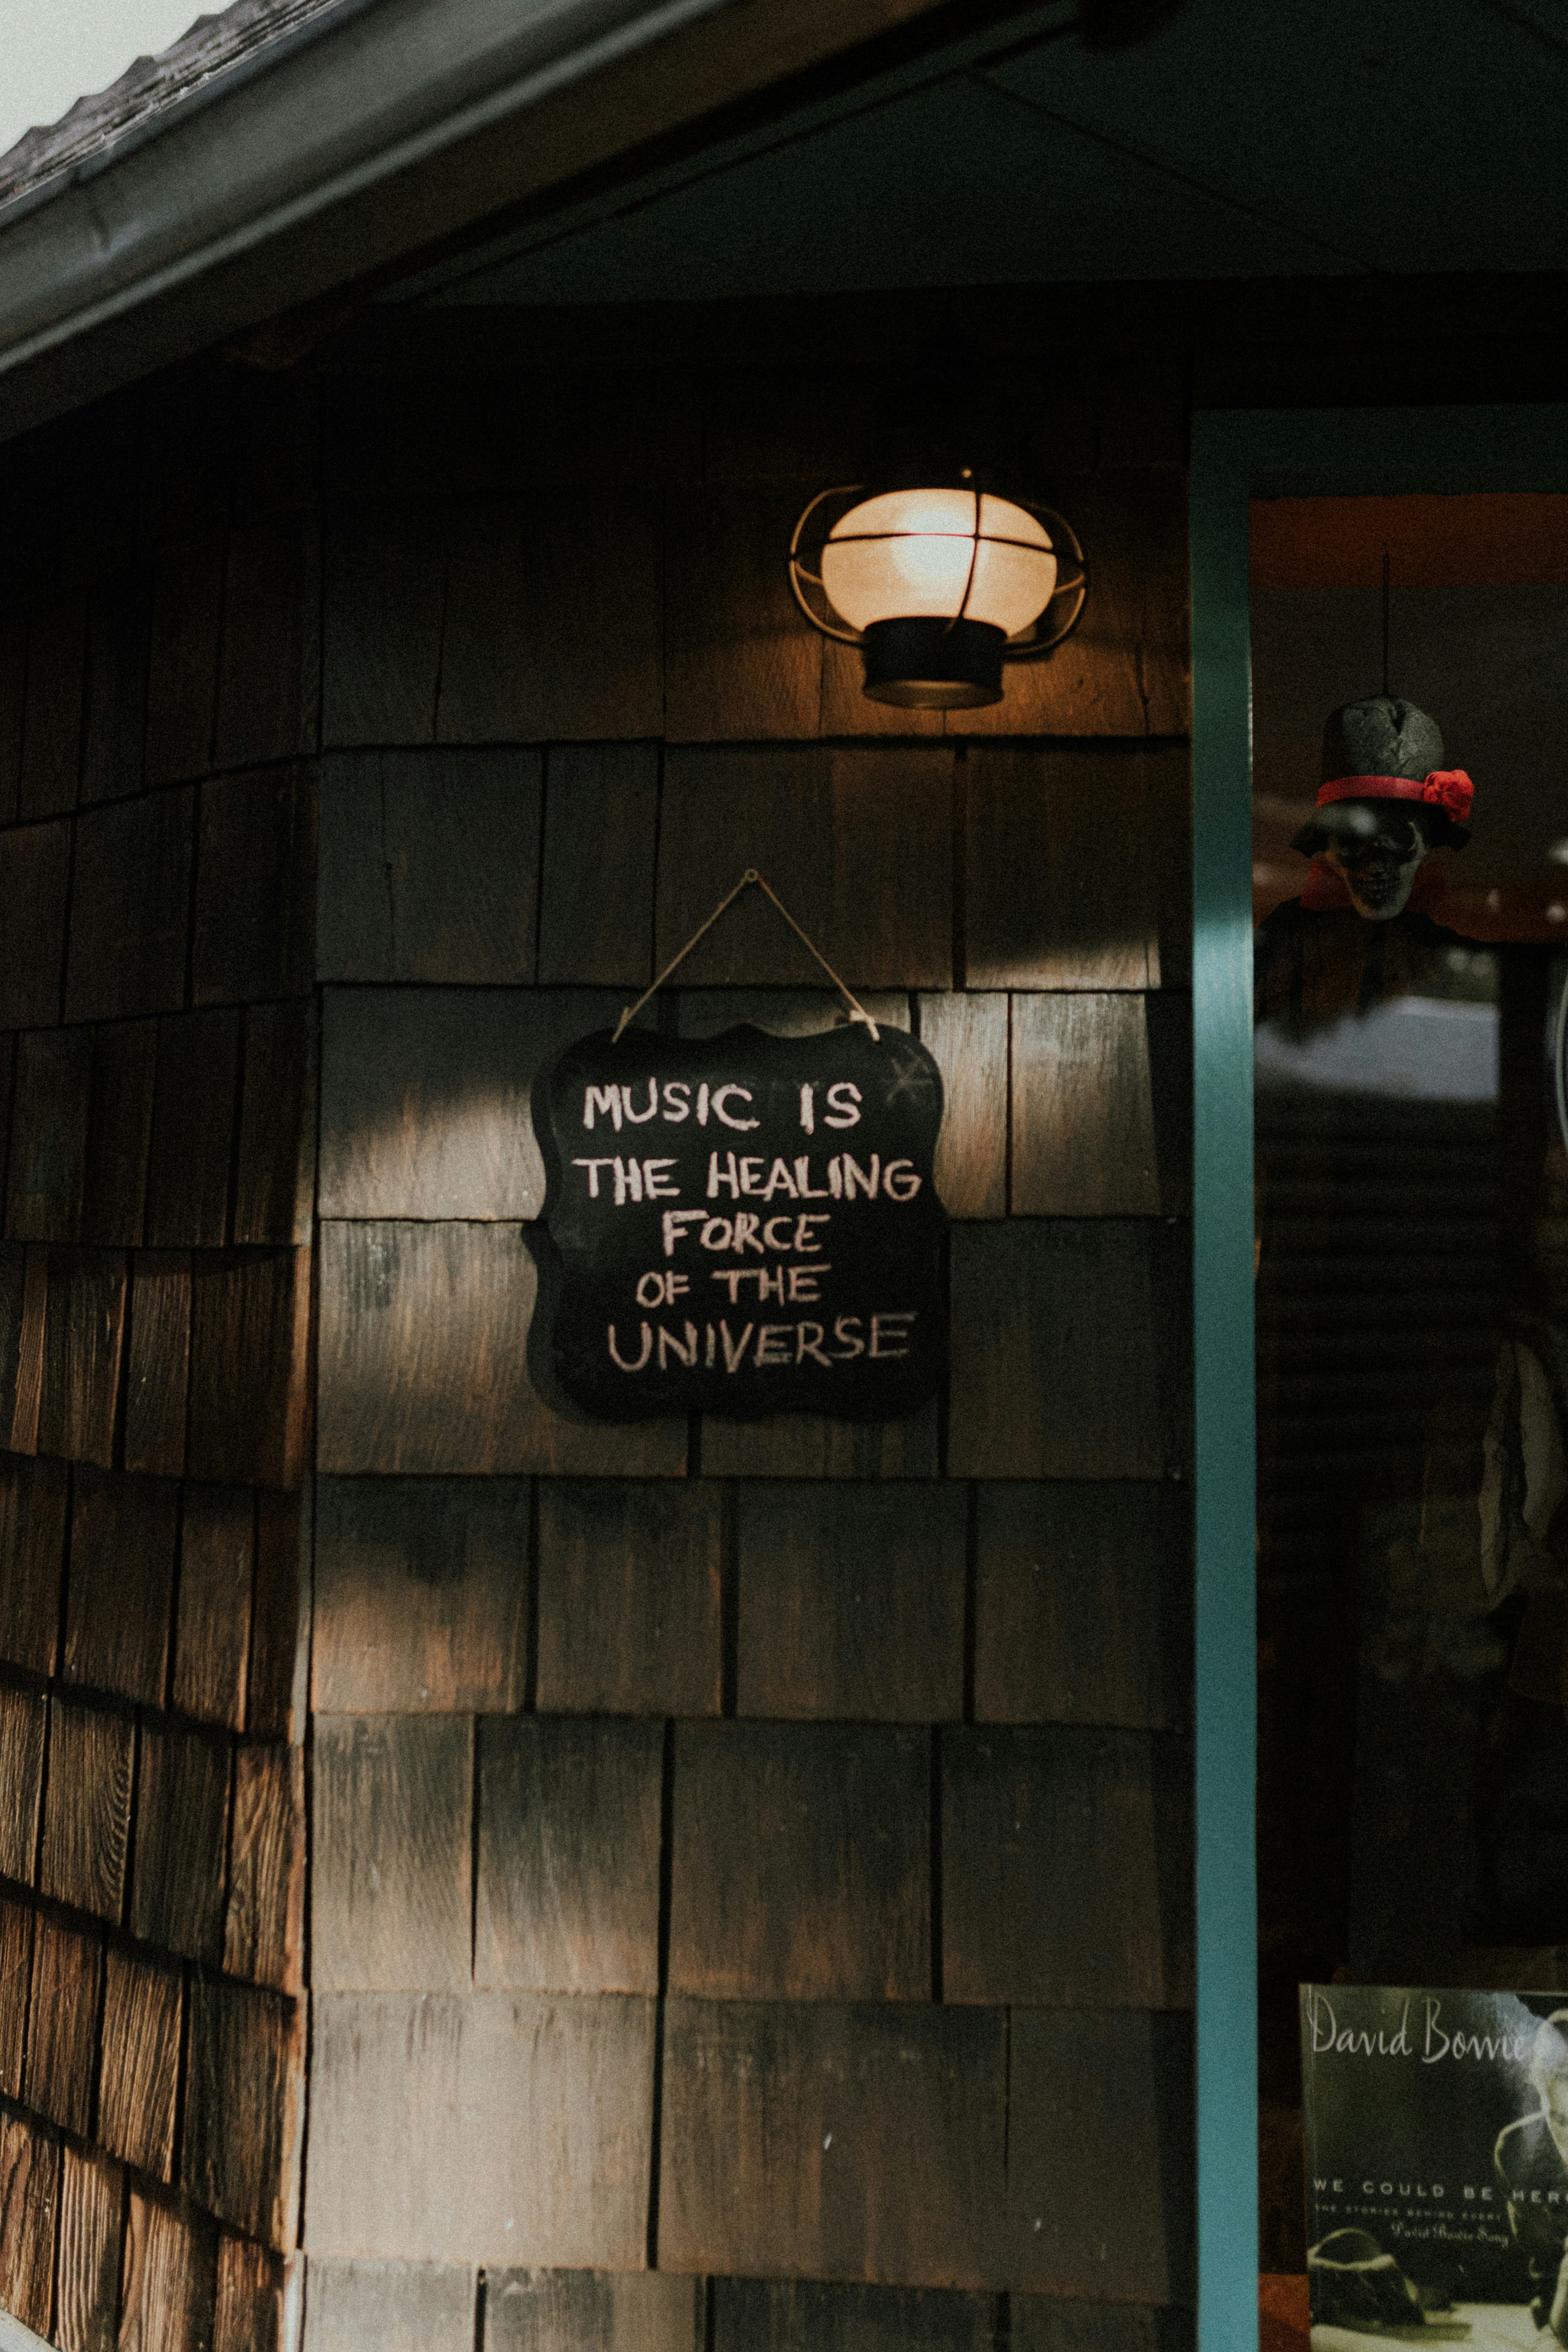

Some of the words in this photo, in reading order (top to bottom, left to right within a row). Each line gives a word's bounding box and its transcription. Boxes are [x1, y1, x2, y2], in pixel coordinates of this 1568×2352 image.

[584, 1077, 760, 1132] MUSIC
[800, 1082, 862, 1135] IS
[572, 1156, 681, 1205] THE
[706, 1151, 922, 1201] HEALING
[662, 1209, 831, 1256] FORCE
[636, 1271, 689, 1308] OF
[712, 1264, 831, 1307] THE
[608, 1311, 918, 1373] UNIVERSE
[1308, 1992, 1412, 2056] David
[1422, 1996, 1525, 2063] Bowie
[1313, 2179, 1343, 2192] WE
[1363, 2180, 1444, 2197] COULD
[1464, 2186, 1493, 2200] BE
[1513, 2190, 1568, 2204] HER
